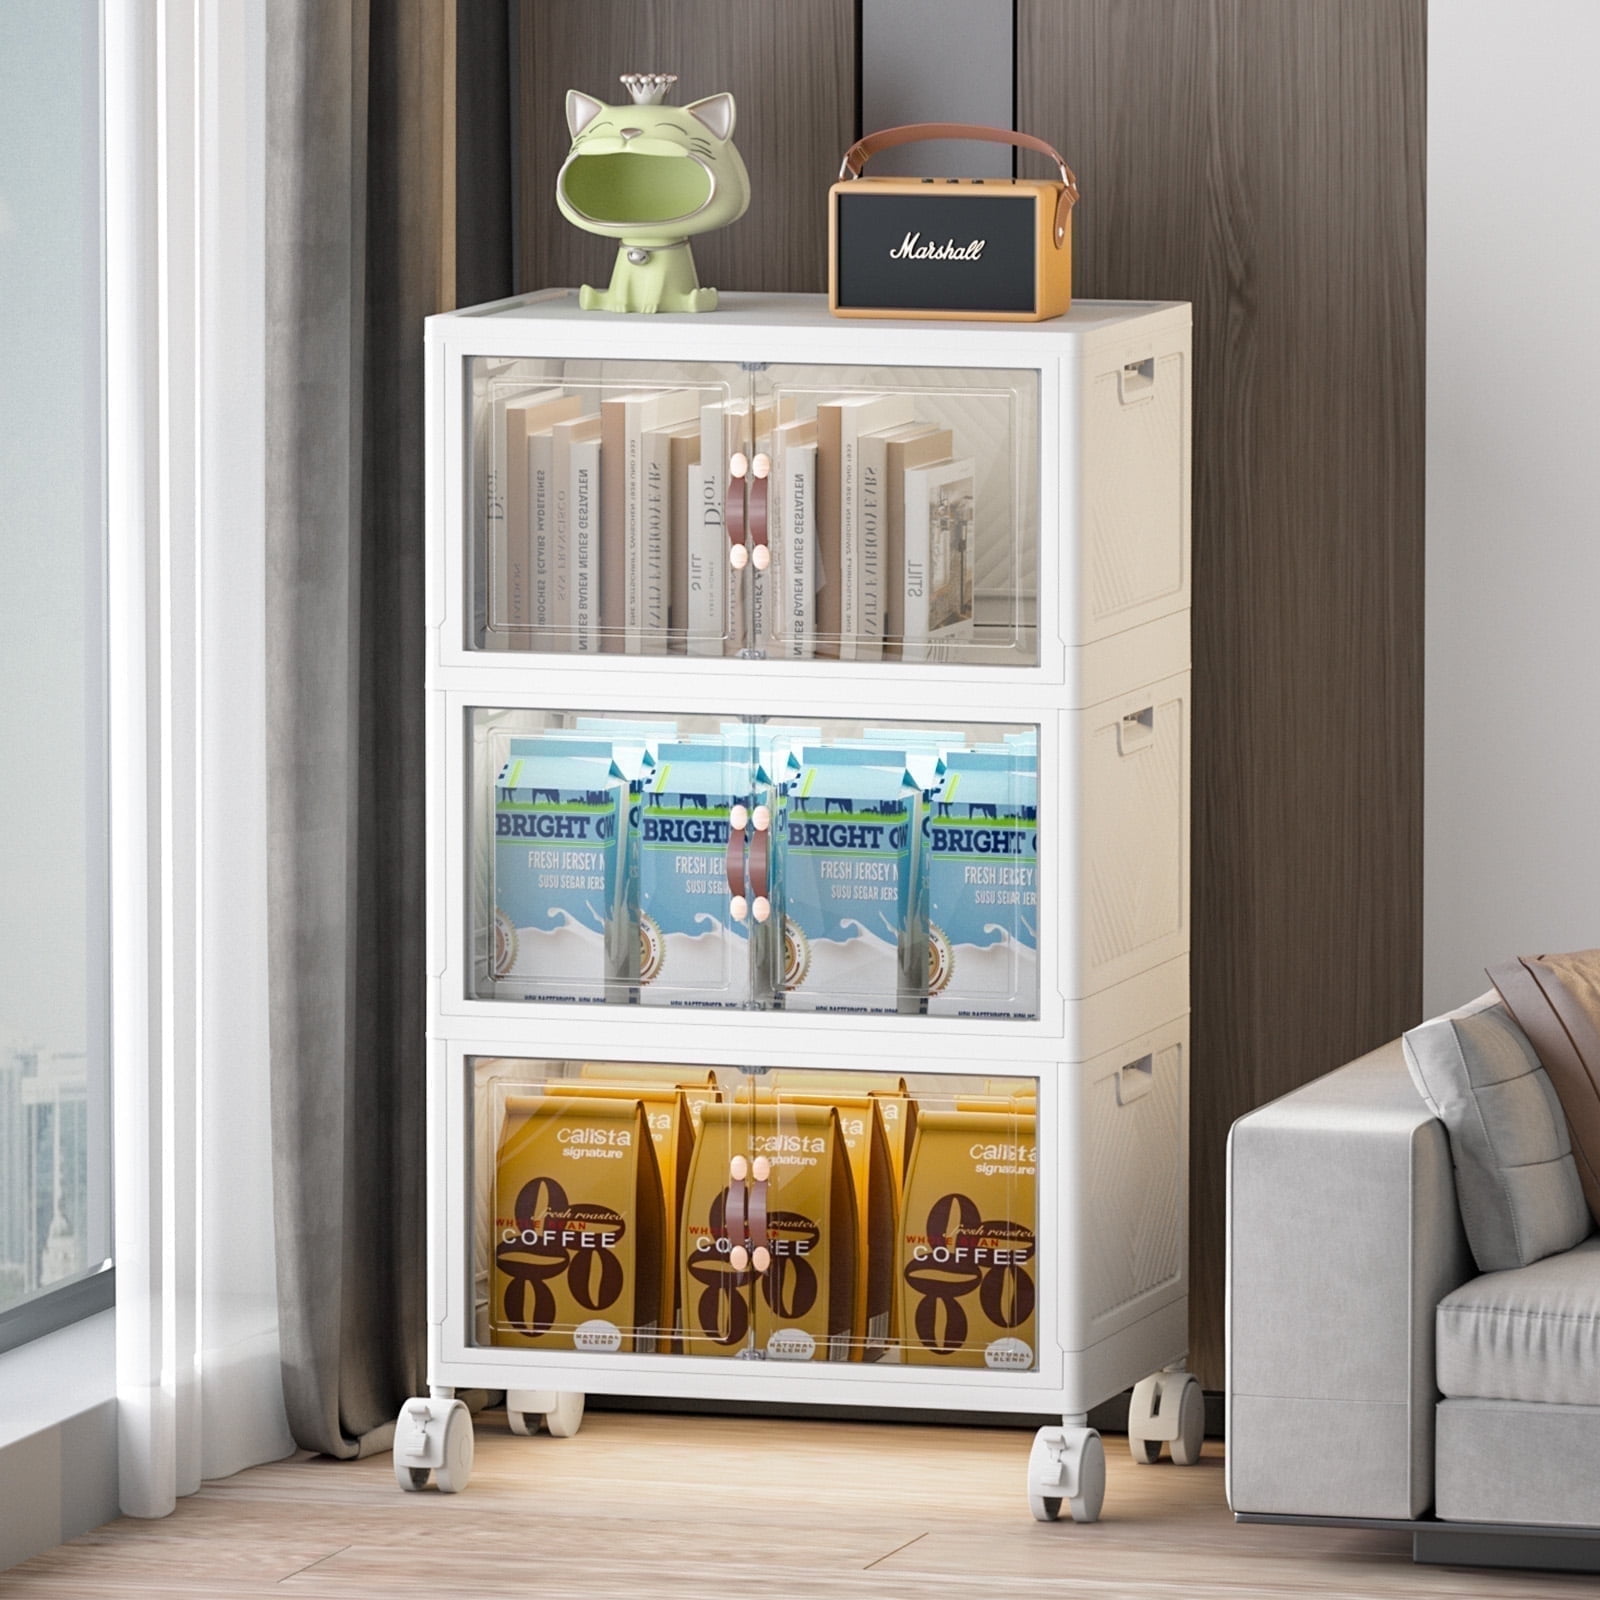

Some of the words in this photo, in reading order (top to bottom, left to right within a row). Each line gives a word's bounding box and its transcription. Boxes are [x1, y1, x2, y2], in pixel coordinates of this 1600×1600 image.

[890, 231, 985, 260] Marshall
[495, 813, 590, 839] BRIGHT
[788, 822, 884, 849] BRIGHT
[931, 828, 1026, 854] BRIGHT
[528, 850, 560, 870] FRESH
[562, 852, 598, 871] JERSEY
[675, 855, 707, 874] FRESH
[820, 860, 852, 880] FRESH
[854, 861, 891, 881] JERSEY
[538, 874, 560, 889] SUSU
[560, 875, 586, 889] SEGAR
[964, 865, 997, 885] FRESH
[998, 867, 1033, 886] JERSEY
[686, 878, 707, 894] SUSU
[831, 884, 853, 900] SUSU
[854, 885, 879, 900] SEGAR
[975, 890, 997, 904] SUSU
[561, 1145, 624, 1160] signature
[767, 1154, 818, 1168] gnature
[976, 1162, 1036, 1176] signature
[530, 1206, 572, 1222] fresh
[573, 1209, 628, 1222] roasted
[501, 1228, 617, 1249] COFFEE
[941, 1223, 985, 1239] fresh
[695, 1235, 811, 1256] COEE
[912, 1244, 1029, 1266] COFFEE
